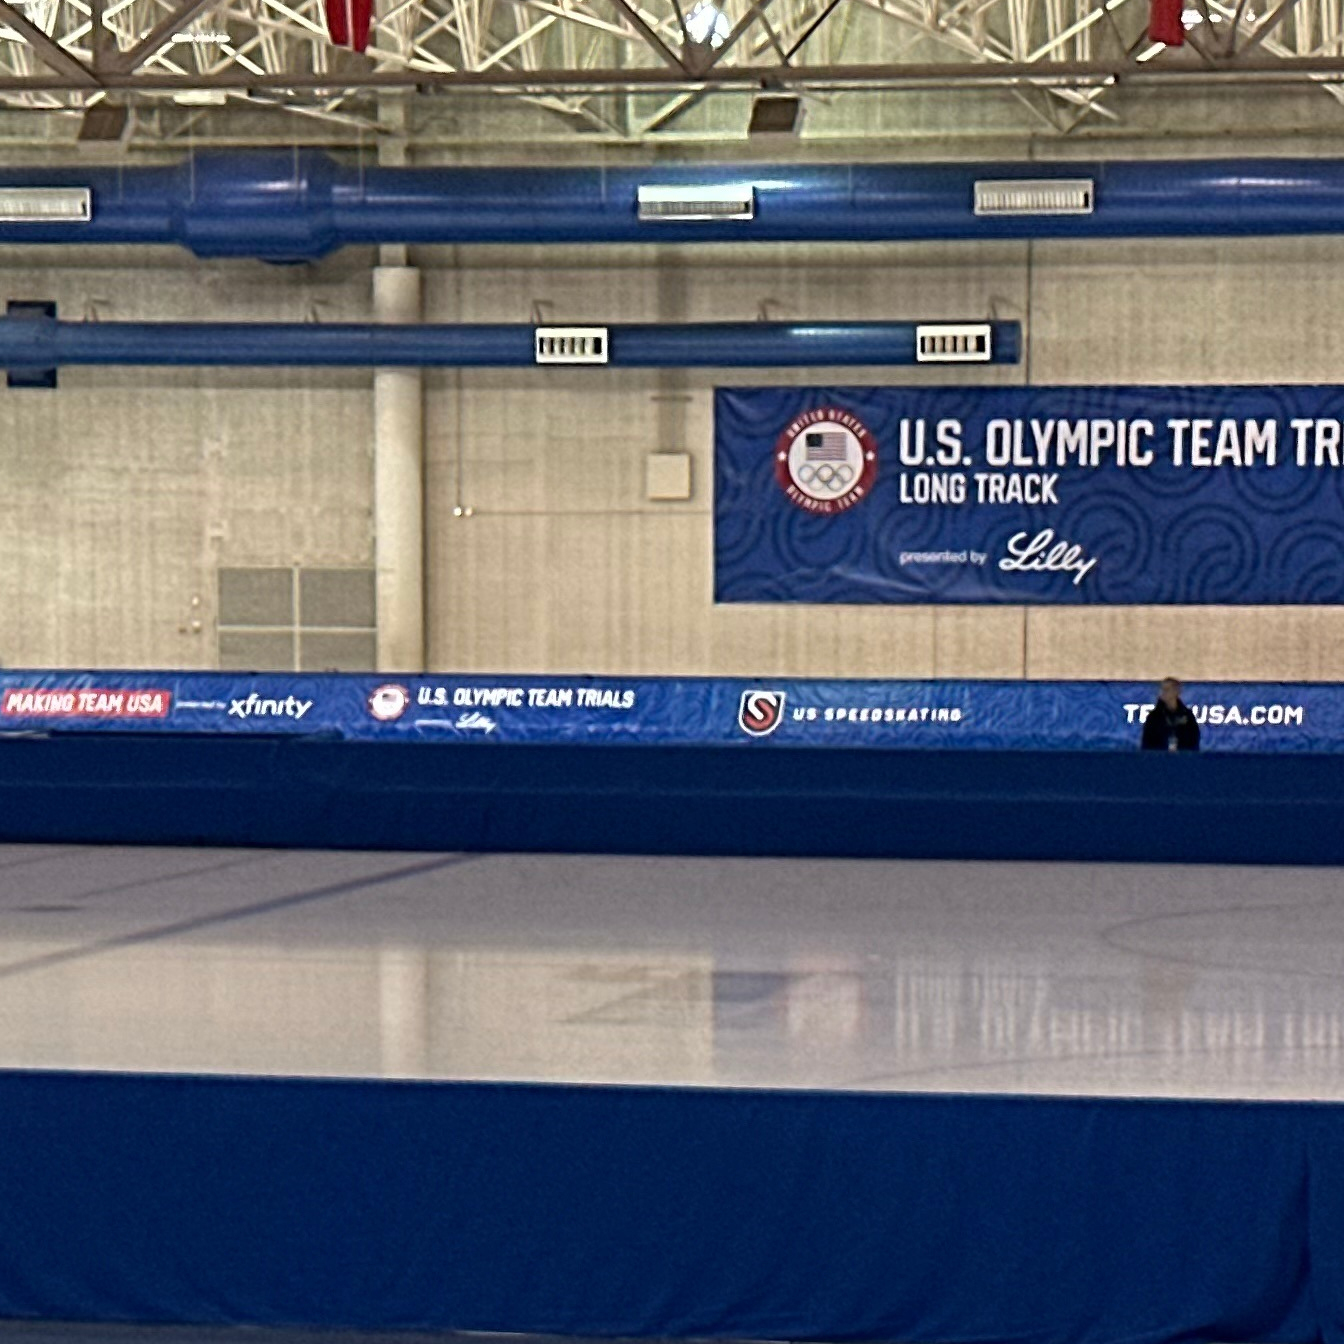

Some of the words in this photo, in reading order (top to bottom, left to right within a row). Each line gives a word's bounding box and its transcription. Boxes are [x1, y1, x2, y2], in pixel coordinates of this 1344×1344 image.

[899, 419, 972, 466] U.S.
[986, 419, 1154, 467] OLYMPIC
[1167, 419, 1277, 467] TEAM
[900, 473, 966, 504] LONG
[974, 473, 1059, 504] TRACK
[899, 550, 967, 567] presented
[969, 551, 987, 566] by
[998, 528, 1097, 585] Lilly
[6, 693, 76, 712] MAKING
[77, 693, 124, 713] TEAM
[126, 694, 163, 713] USA
[227, 693, 313, 719] xfinity
[417, 686, 448, 705] U.S.
[453, 687, 525, 707] OLYMPIC
[527, 688, 573, 707] TEAM
[576, 688, 635, 708] TRIALS
[793, 708, 817, 721] US
[824, 707, 962, 722] SPEEDSKATING
